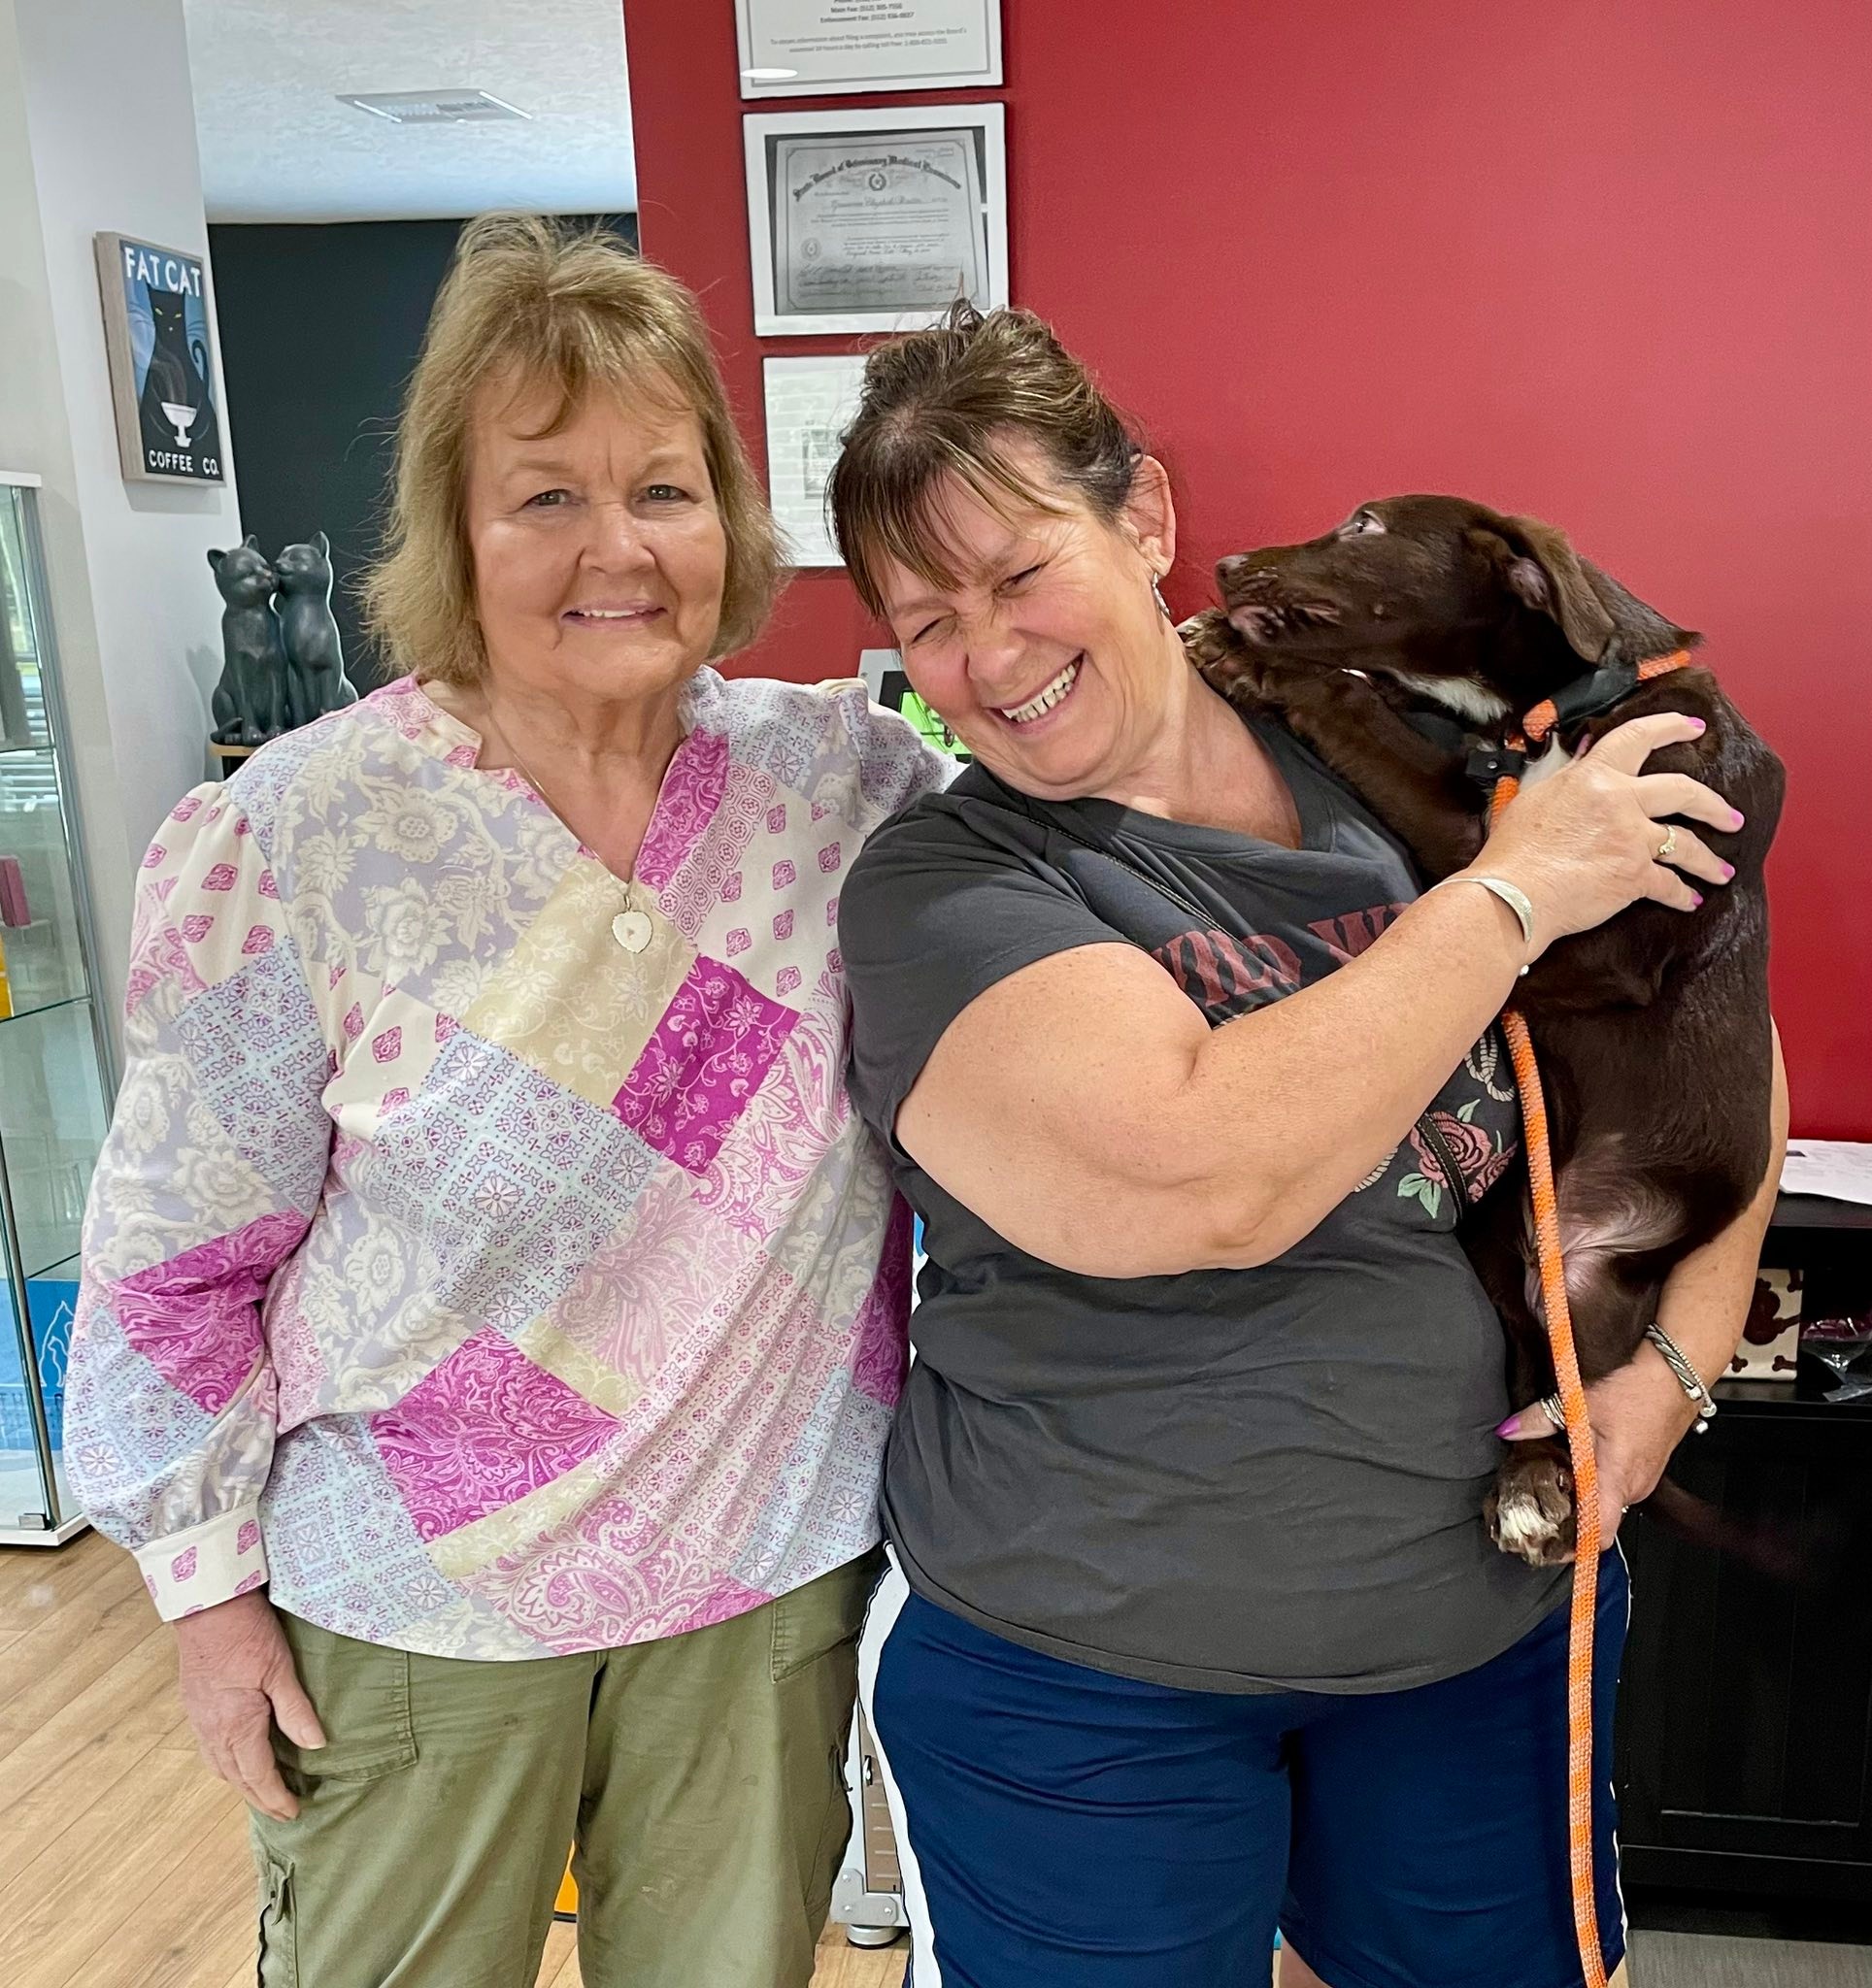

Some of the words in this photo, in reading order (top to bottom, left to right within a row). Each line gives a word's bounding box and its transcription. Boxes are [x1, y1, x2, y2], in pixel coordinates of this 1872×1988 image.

[124, 247, 160, 287] FAT
[165, 259, 201, 298] CAT
[149, 449, 194, 473] COFFEE
[202, 457, 220, 476] CO.
